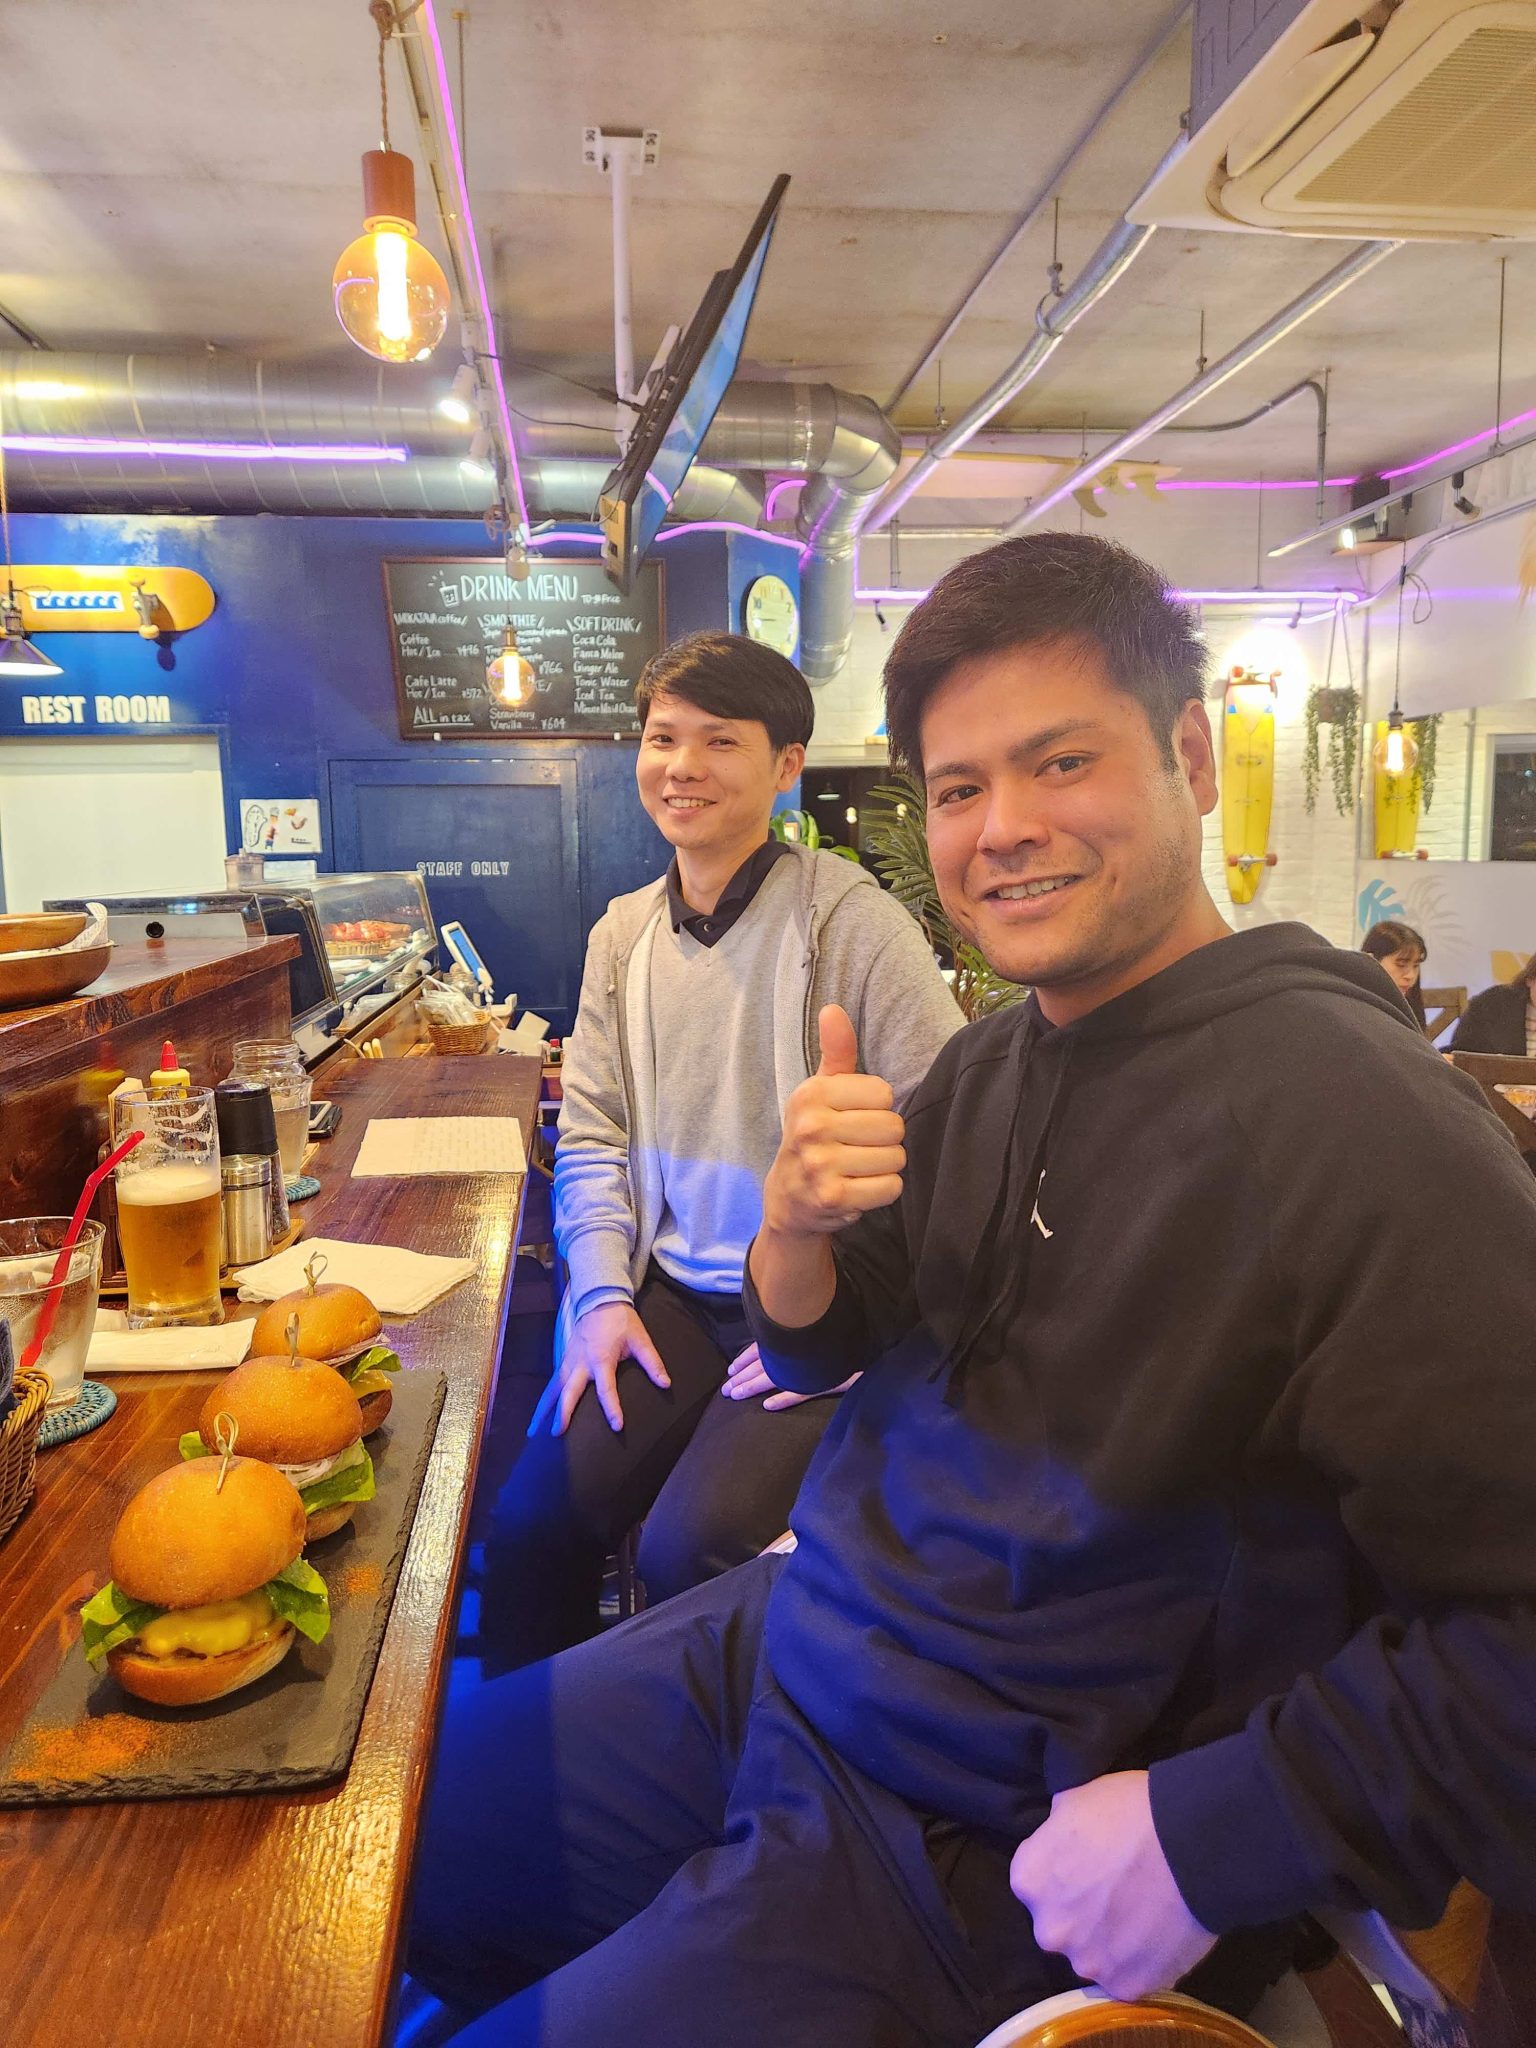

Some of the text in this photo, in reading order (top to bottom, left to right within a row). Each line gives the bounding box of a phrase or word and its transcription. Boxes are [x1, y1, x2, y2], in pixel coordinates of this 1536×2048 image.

[460, 574, 578, 602] DRINK MENU
[573, 616, 635, 632] SOFT DRINK
[400, 632, 430, 645] Coffee
[572, 633, 617, 646] Coca Cola
[600, 647, 624, 660] Melon
[573, 660, 619, 675] Ginger Ale
[430, 675, 457, 687] Latte
[573, 675, 629, 687] Tonic Water
[574, 687, 615, 700] Iced Tea
[21, 695, 171, 724] REST ROOM
[413, 705, 471, 724] ALL in tax
[489, 707, 535, 720] Strawberry
[490, 720, 522, 730] Vanilla
[416, 861, 510, 876] STAFF ONLY
